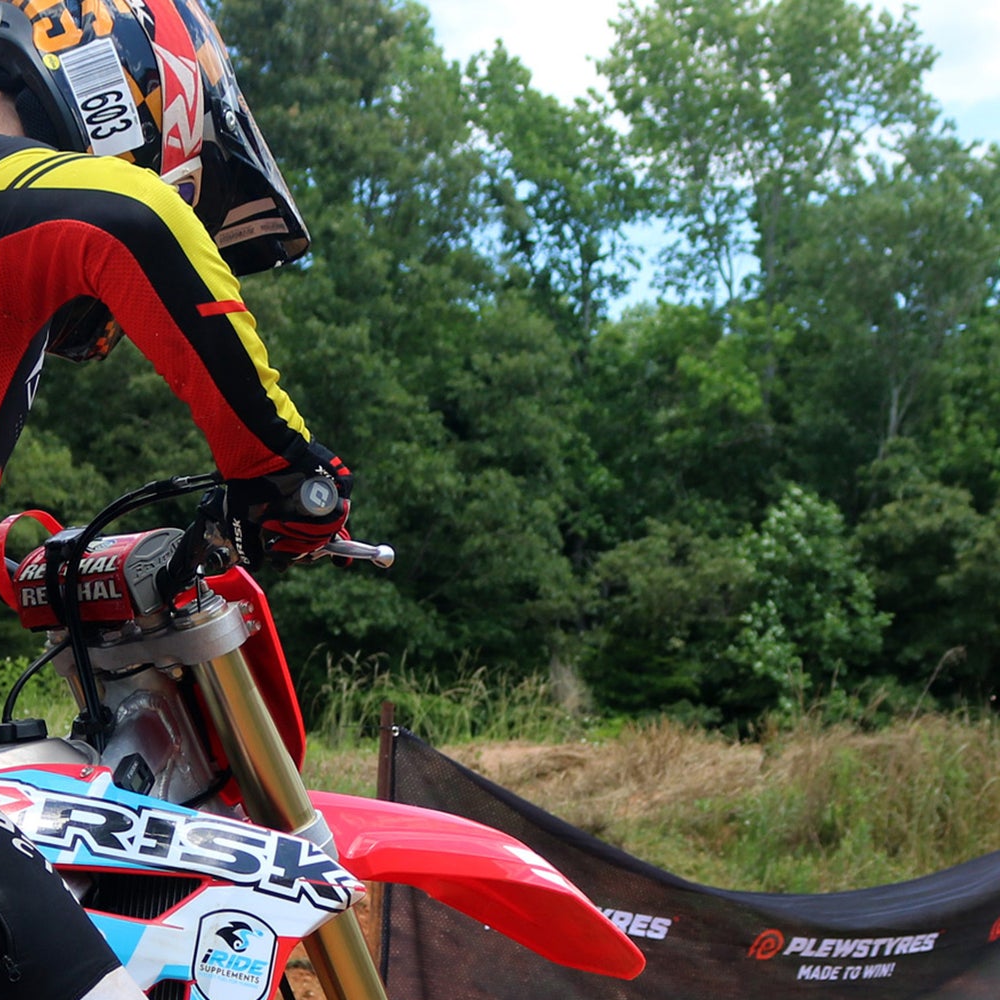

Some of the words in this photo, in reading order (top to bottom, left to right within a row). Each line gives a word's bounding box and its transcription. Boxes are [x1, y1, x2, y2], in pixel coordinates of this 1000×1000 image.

[80, 90, 132, 141] 603
[19, 554, 119, 582] REHAL
[21, 580, 123, 607] REHAL
[34, 797, 353, 906] RISK
[199, 963, 260, 985] SUPPLEMENTS
[796, 964, 842, 981] MADE
[842, 965, 862, 980] TO
[861, 962, 897, 979] WIN!
